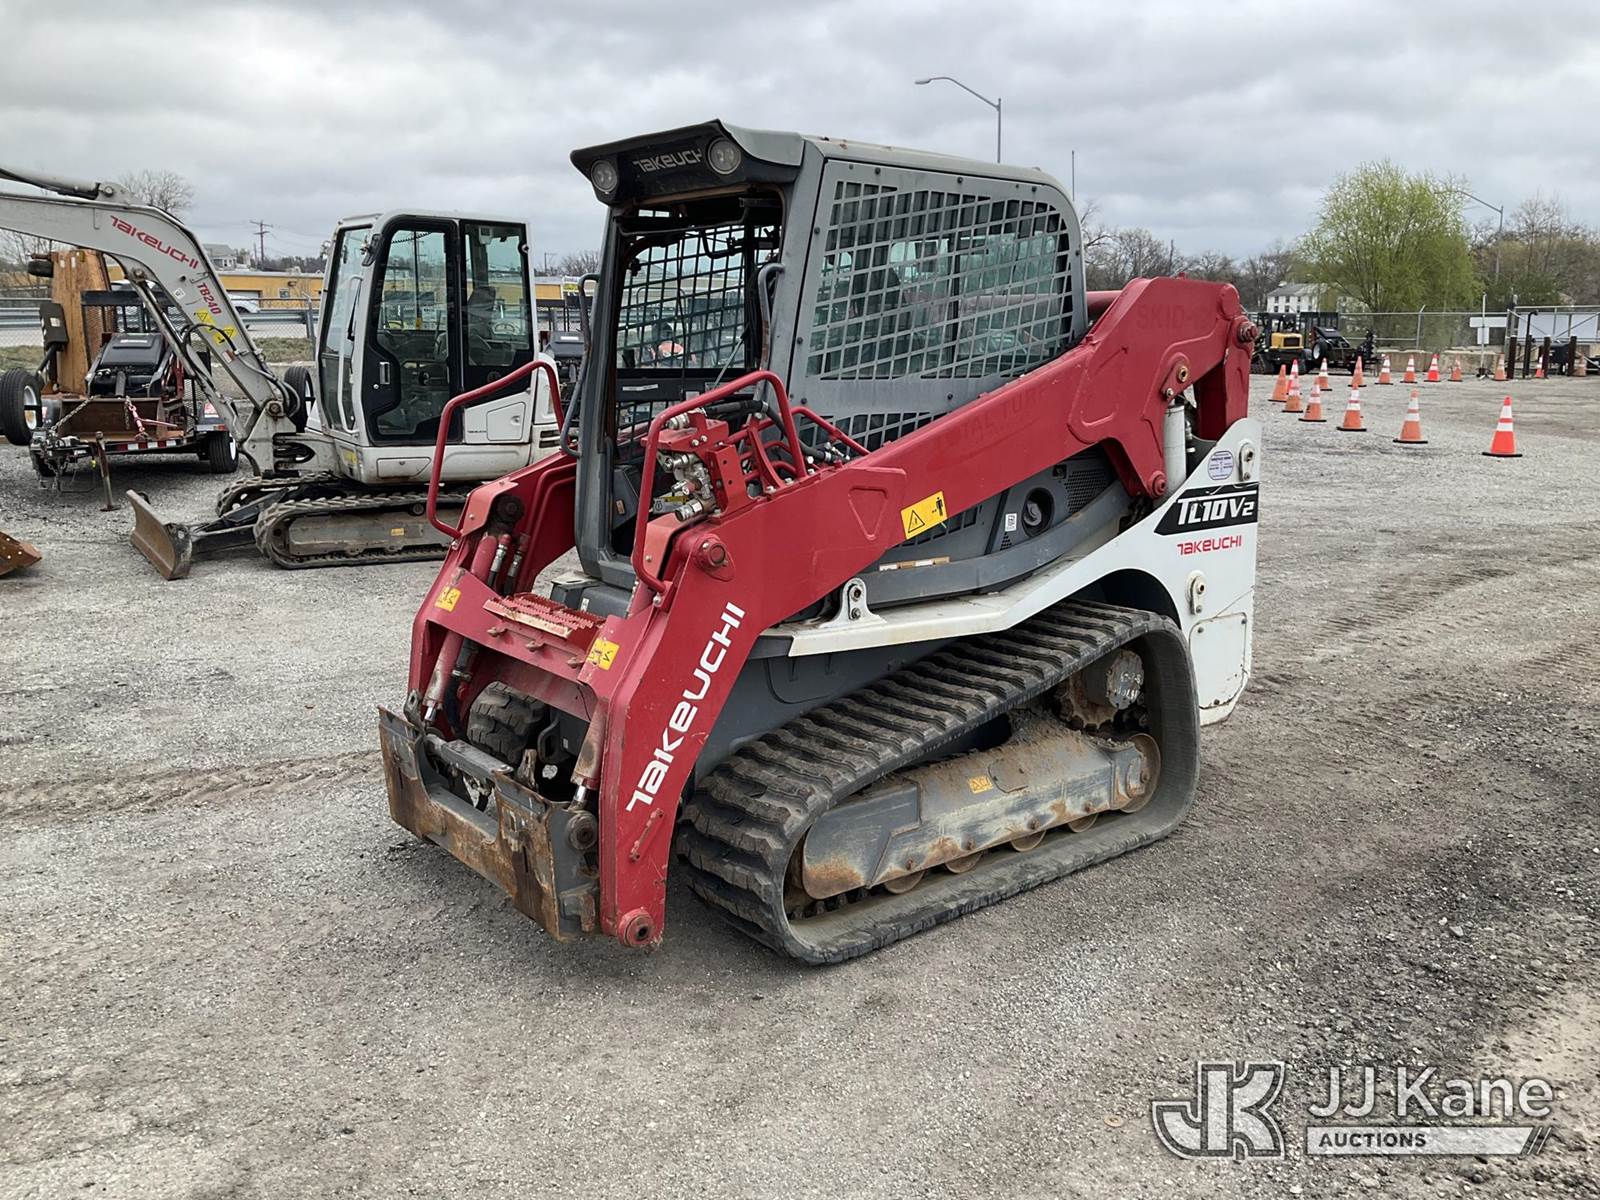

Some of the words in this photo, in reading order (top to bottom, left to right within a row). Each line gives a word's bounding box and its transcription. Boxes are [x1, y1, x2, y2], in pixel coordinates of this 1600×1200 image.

[110, 215, 199, 269] TAKEUCHI
[197, 282, 222, 315] TB240
[1175, 491, 1256, 526] TL10V2
[1176, 535, 1242, 556] TAKEUCHI
[625, 601, 746, 812] TAKEUCHI
